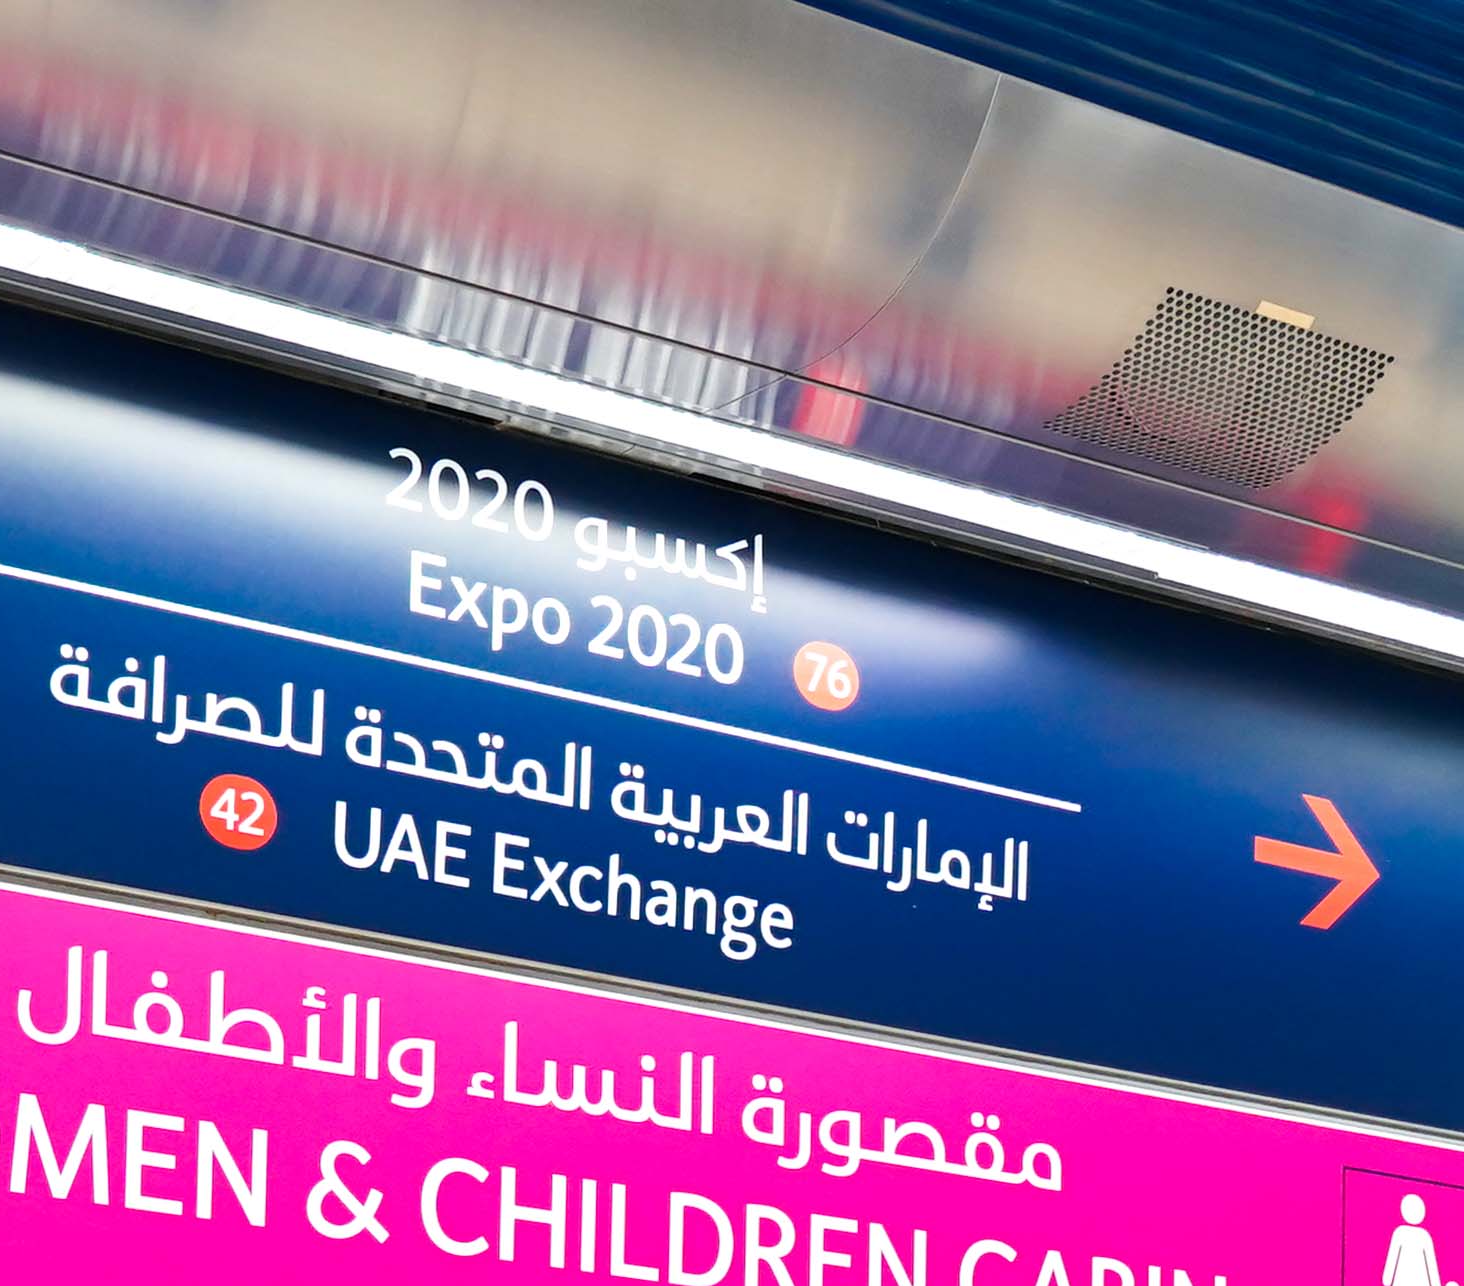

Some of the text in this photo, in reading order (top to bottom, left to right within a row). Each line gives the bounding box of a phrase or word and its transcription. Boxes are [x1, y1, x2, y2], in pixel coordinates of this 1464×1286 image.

[386, 448, 768, 614] إكسبو 2020
[407, 550, 746, 687] Expo 2020
[802, 647, 854, 700] 76
[47, 642, 1030, 912] الإمارات العربية المتحدة للصرافة
[208, 785, 267, 840] 42
[333, 800, 796, 962] UAE Exchange
[16, 943, 1065, 1197] مقصورة النساء والأطفال
[304, 1138, 393, 1244] &
